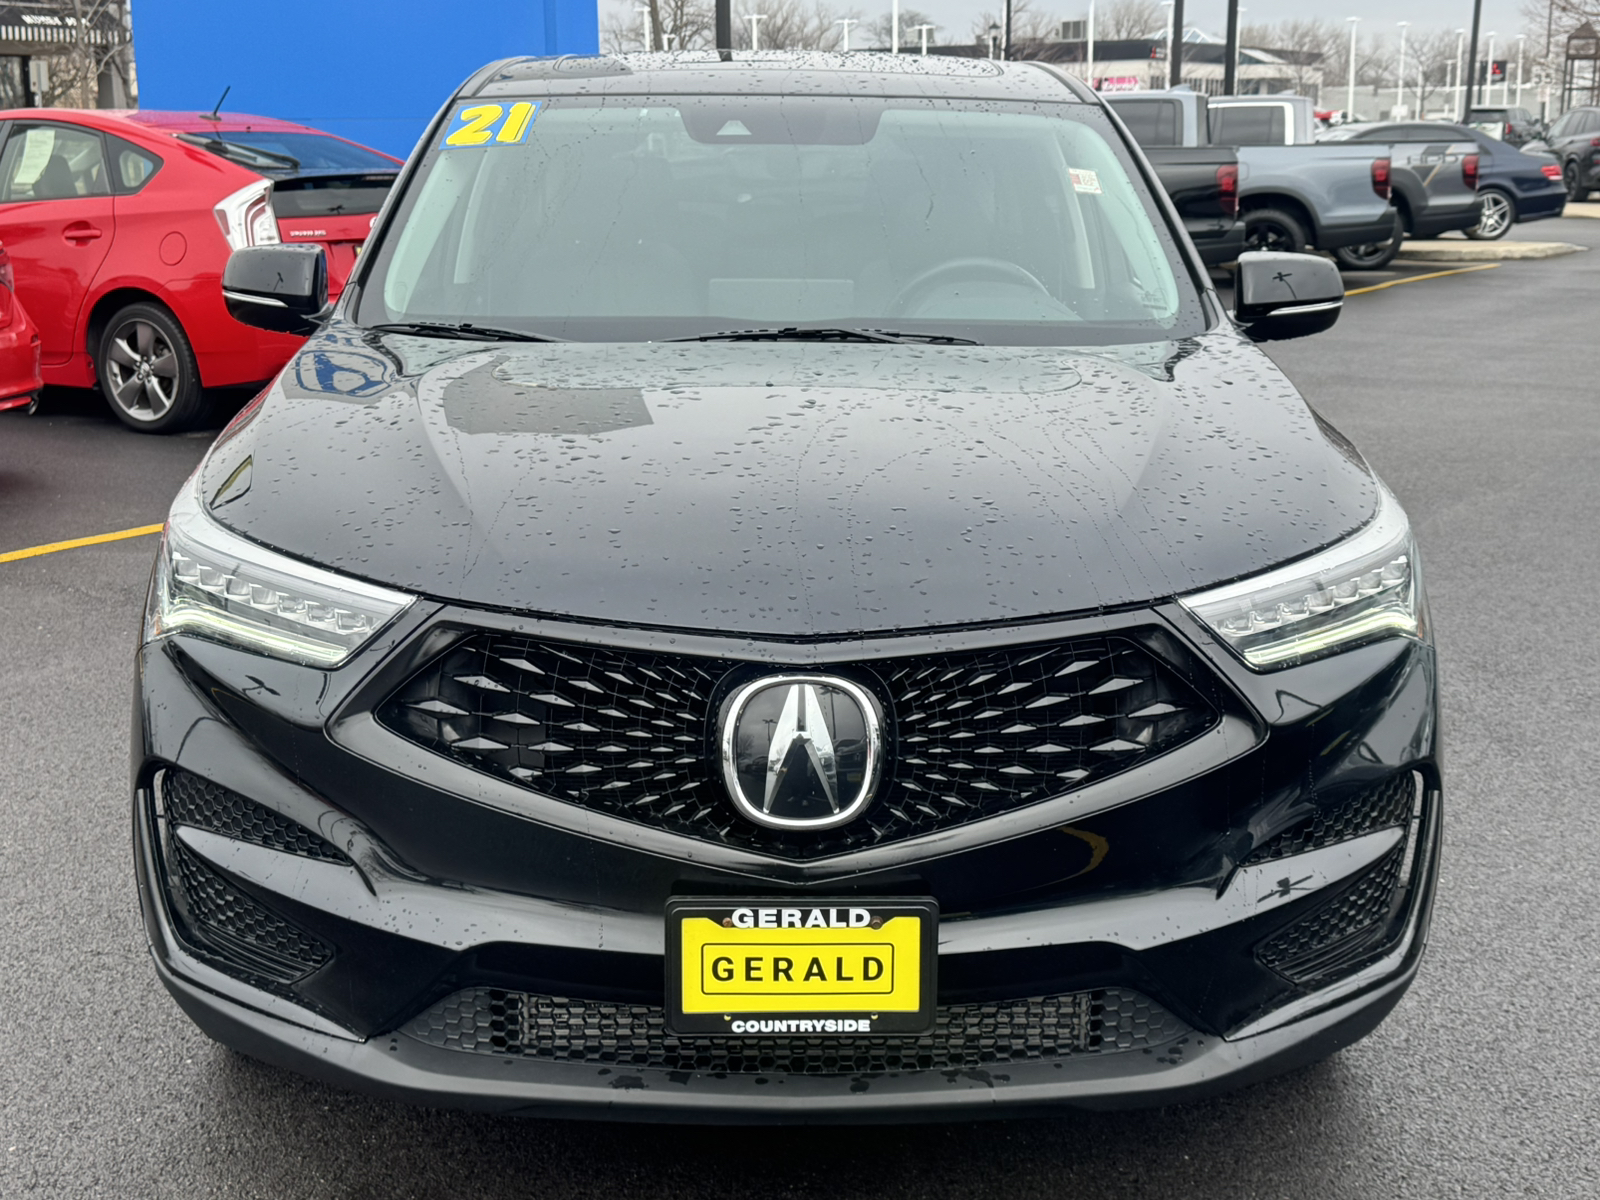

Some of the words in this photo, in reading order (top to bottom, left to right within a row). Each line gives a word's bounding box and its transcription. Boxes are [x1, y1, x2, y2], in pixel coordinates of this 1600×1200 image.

[445, 101, 536, 146] 21
[731, 908, 871, 929] GERALD
[711, 956, 884, 982] GERALD
[731, 1019, 871, 1033] COUNTRYSIDE
